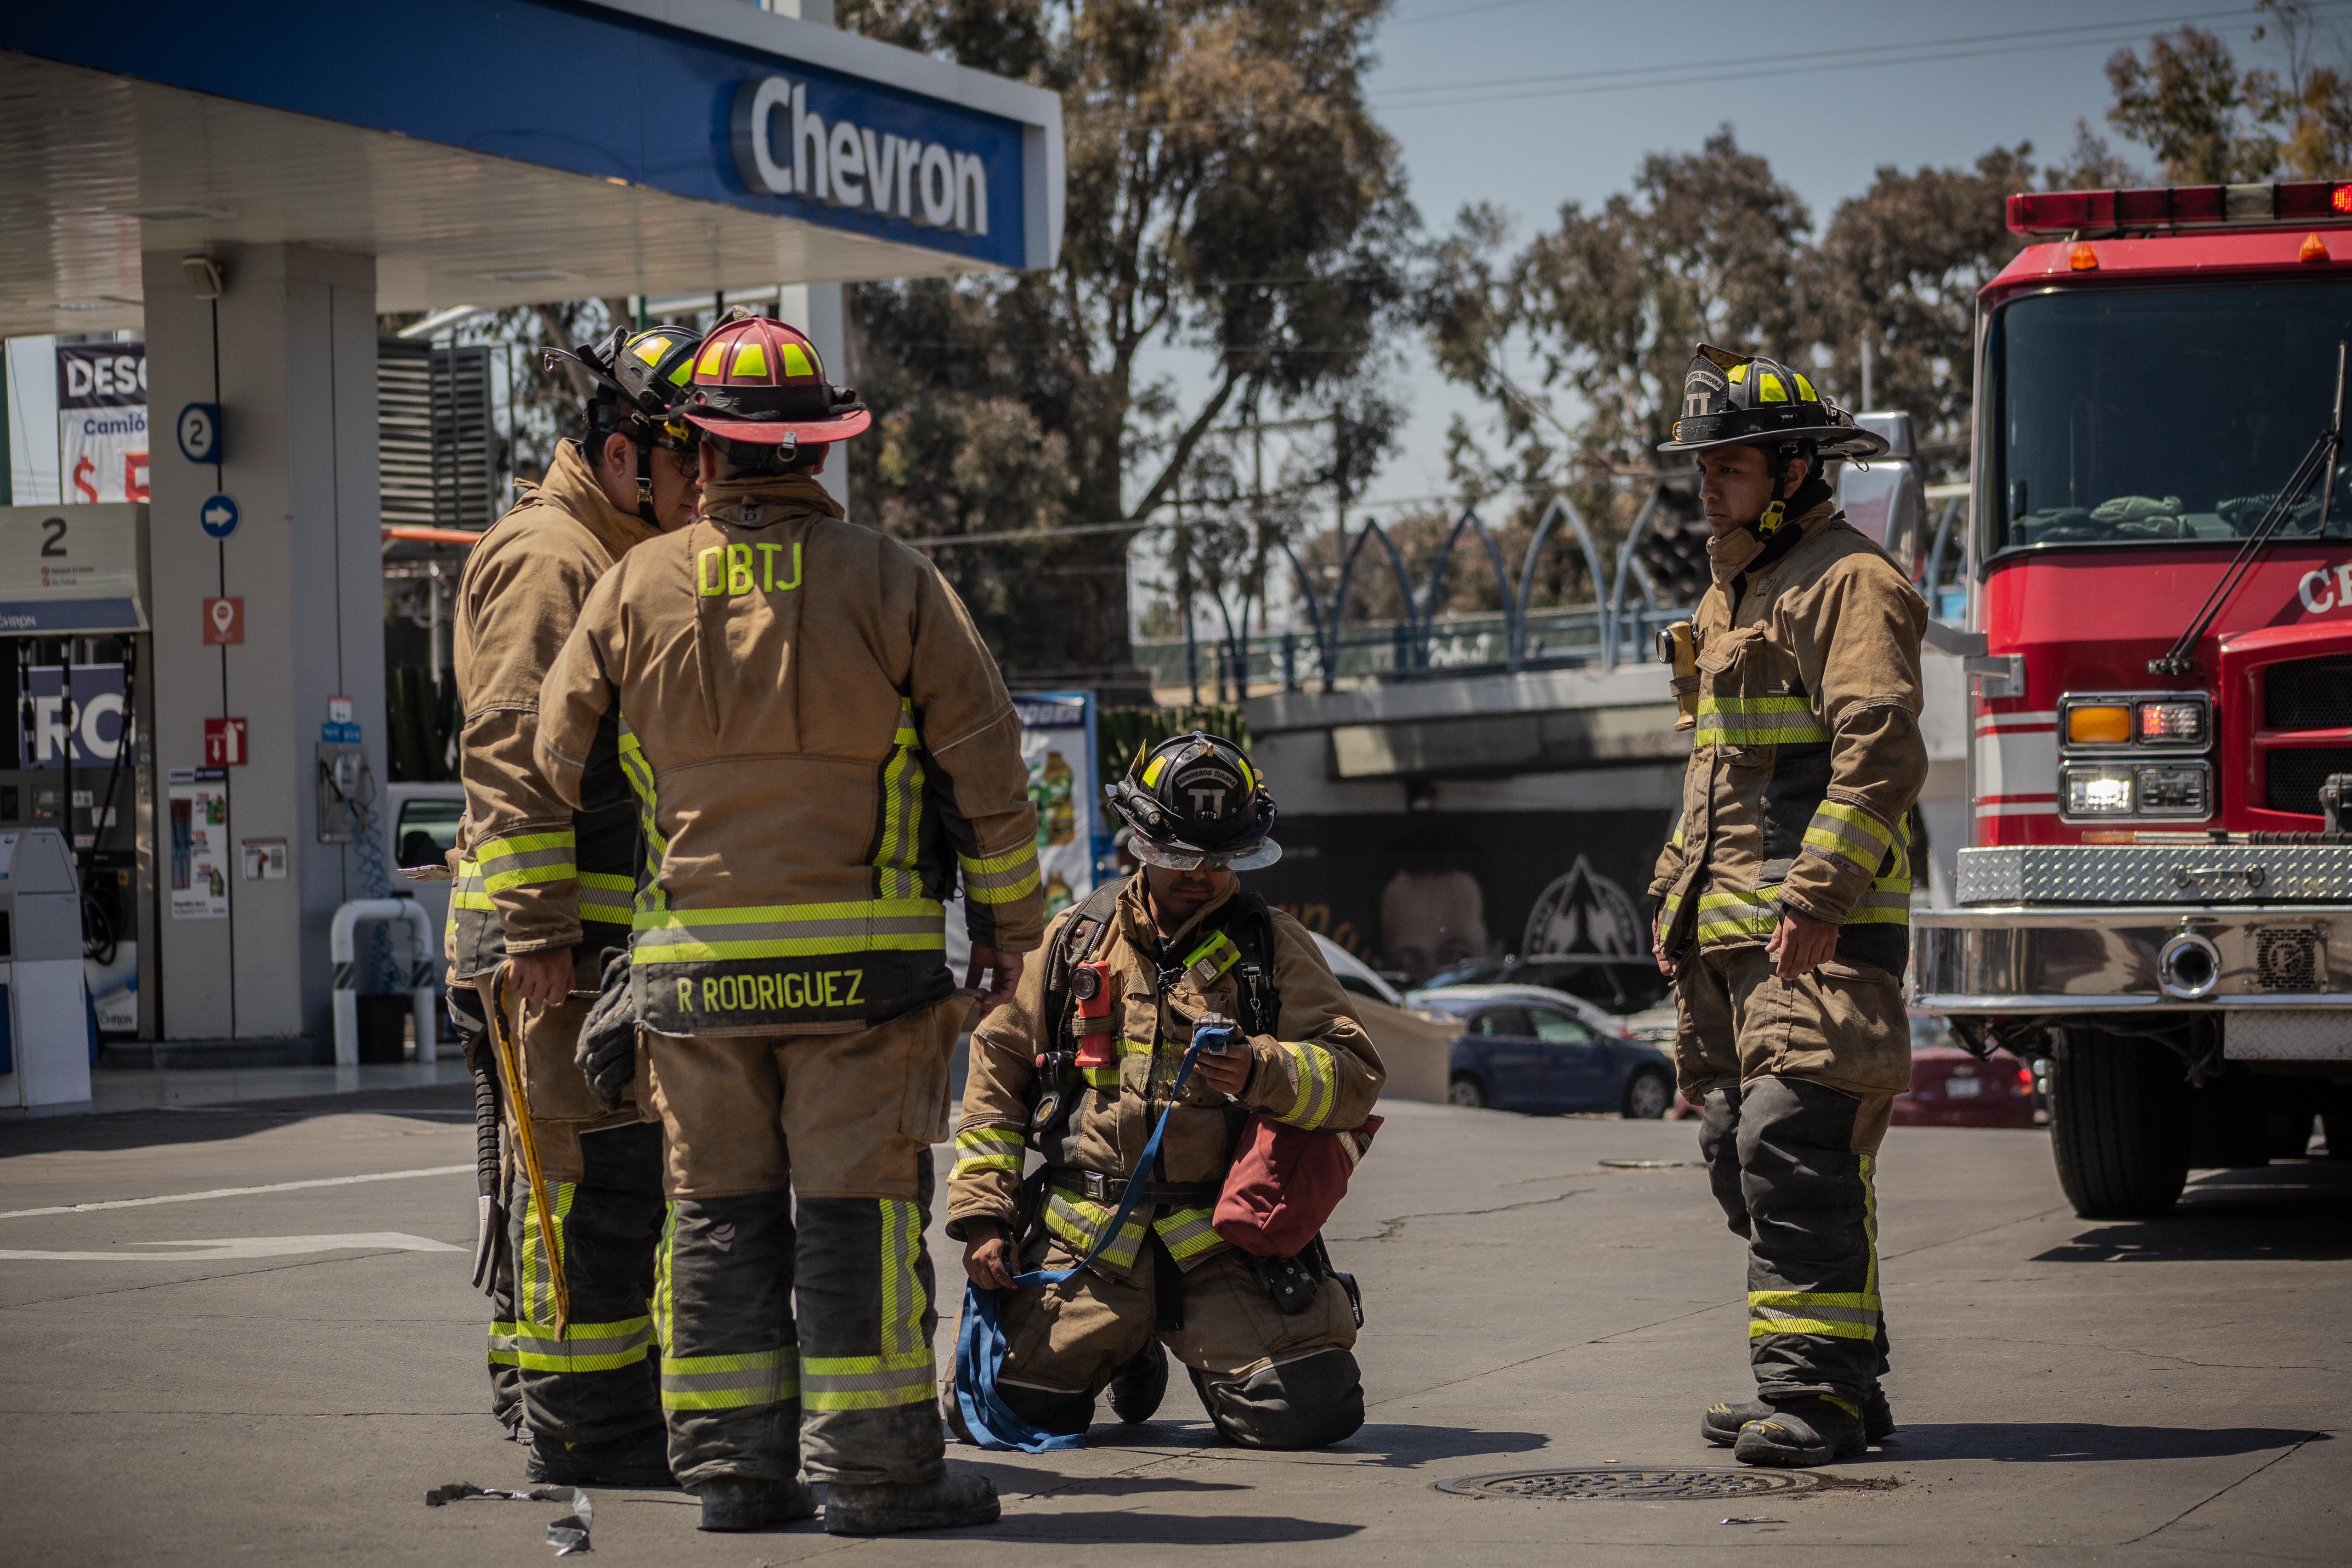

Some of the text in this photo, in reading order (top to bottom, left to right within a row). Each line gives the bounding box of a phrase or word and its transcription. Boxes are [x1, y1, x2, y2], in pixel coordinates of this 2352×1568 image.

[752, 77, 989, 235] Chevron
[1701, 373, 1723, 389] TIJUANA
[189, 420, 204, 445] 2
[74, 456, 98, 504] $
[41, 518, 67, 557] 2
[698, 542, 802, 597] DBTJ
[1178, 770, 1236, 786] BOMBEROS TIJUANA
[1805, 846, 1850, 870] ENERGY GRAY
[677, 969, 865, 1012] R RODRIGUEZ
